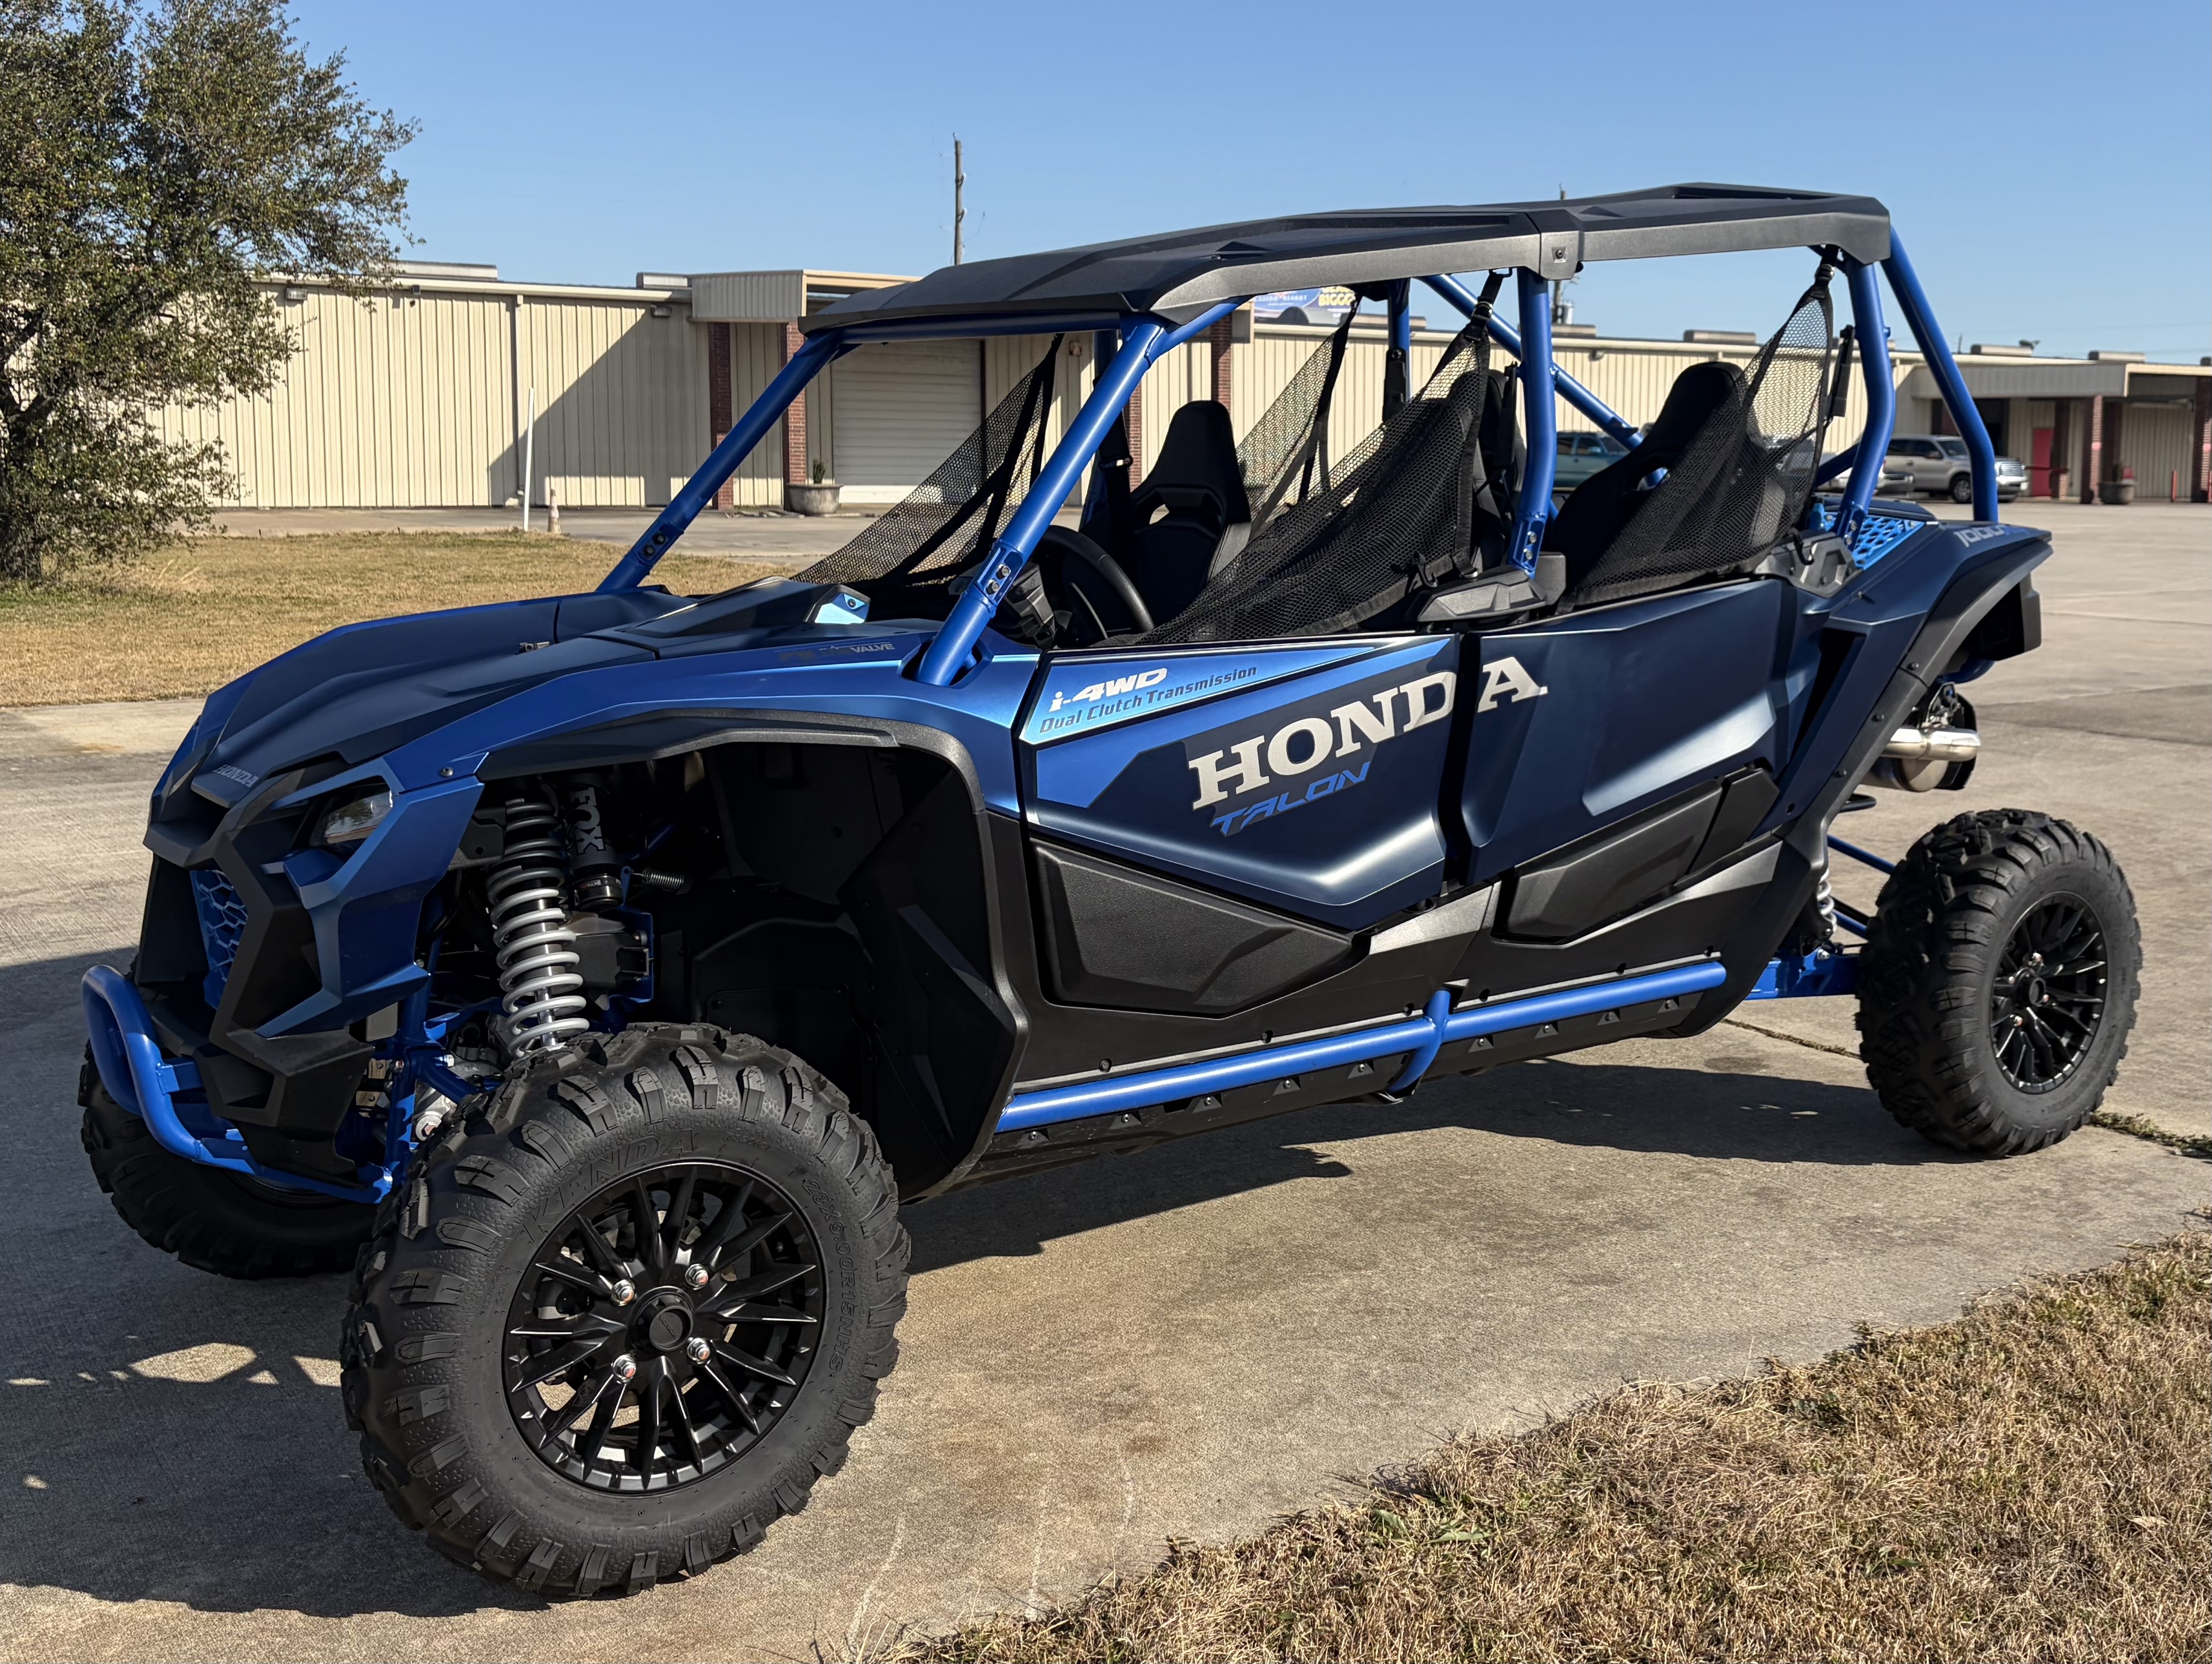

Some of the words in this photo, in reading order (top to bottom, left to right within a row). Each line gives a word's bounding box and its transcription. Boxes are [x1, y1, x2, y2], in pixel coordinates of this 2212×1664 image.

[850, 643, 895, 653] VALVE
[1039, 709, 1082, 734] Dual
[1087, 696, 1142, 721] Clutch
[1145, 667, 1257, 704] Transmission
[1048, 667, 1168, 712] i-4WD
[1189, 656, 1549, 810] HONDA
[212, 764, 259, 788] HONDA
[1211, 761, 1371, 835] TALON
[568, 787, 605, 854] FOX
